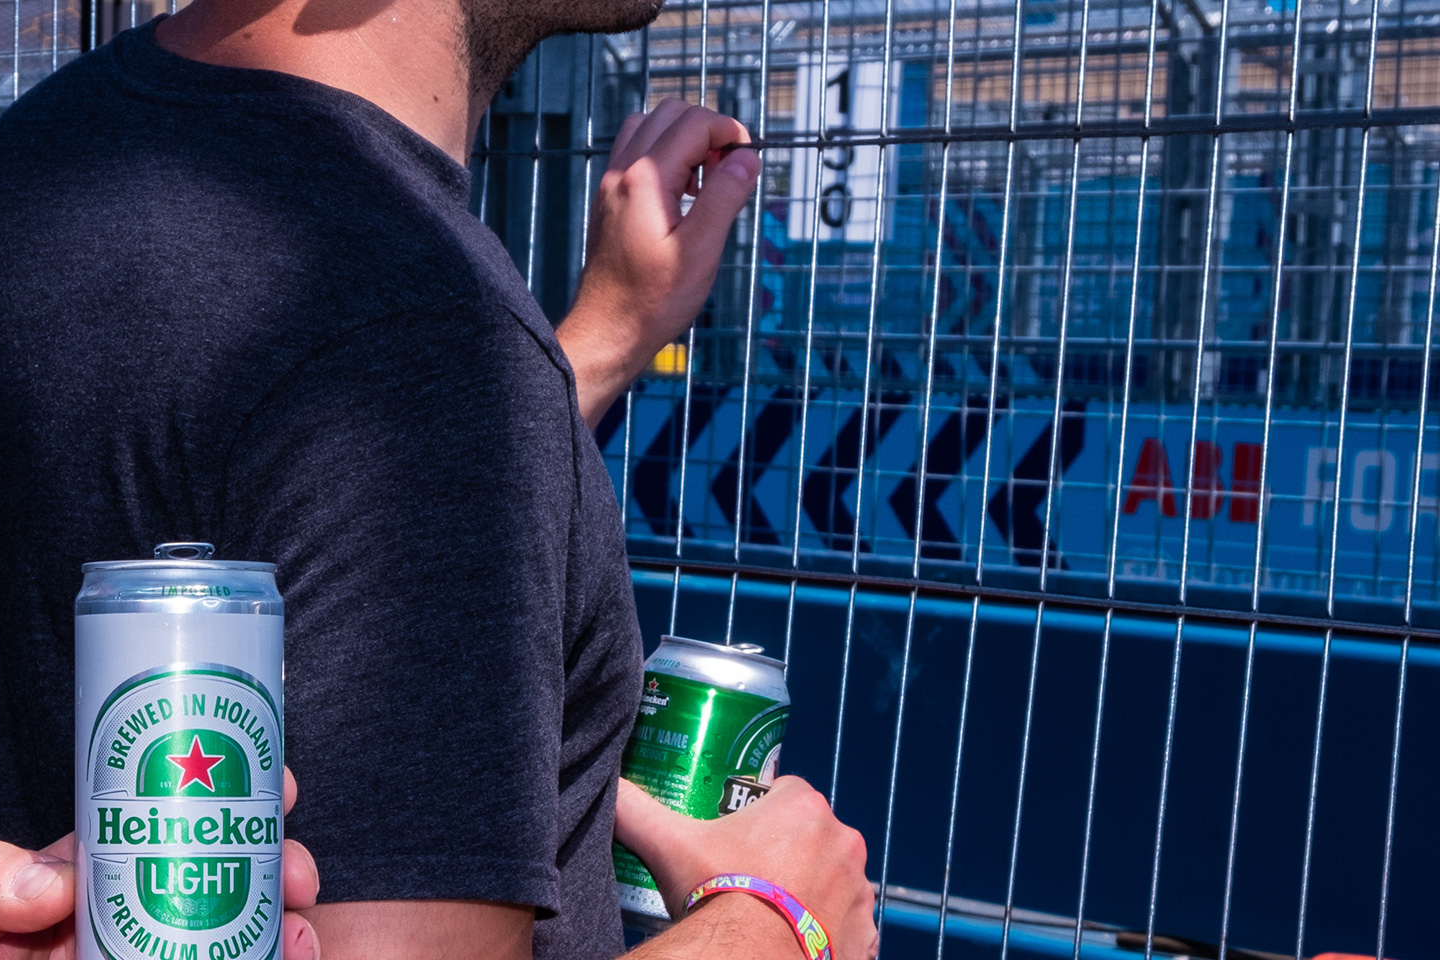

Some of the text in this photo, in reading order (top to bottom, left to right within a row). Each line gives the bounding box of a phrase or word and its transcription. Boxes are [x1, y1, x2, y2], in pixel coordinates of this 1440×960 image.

[107, 693, 274, 771] BREWED IN HOLLAND
[657, 729, 689, 749] NAME
[96, 806, 279, 845] Heineken
[150, 862, 240, 895] LIGHT
